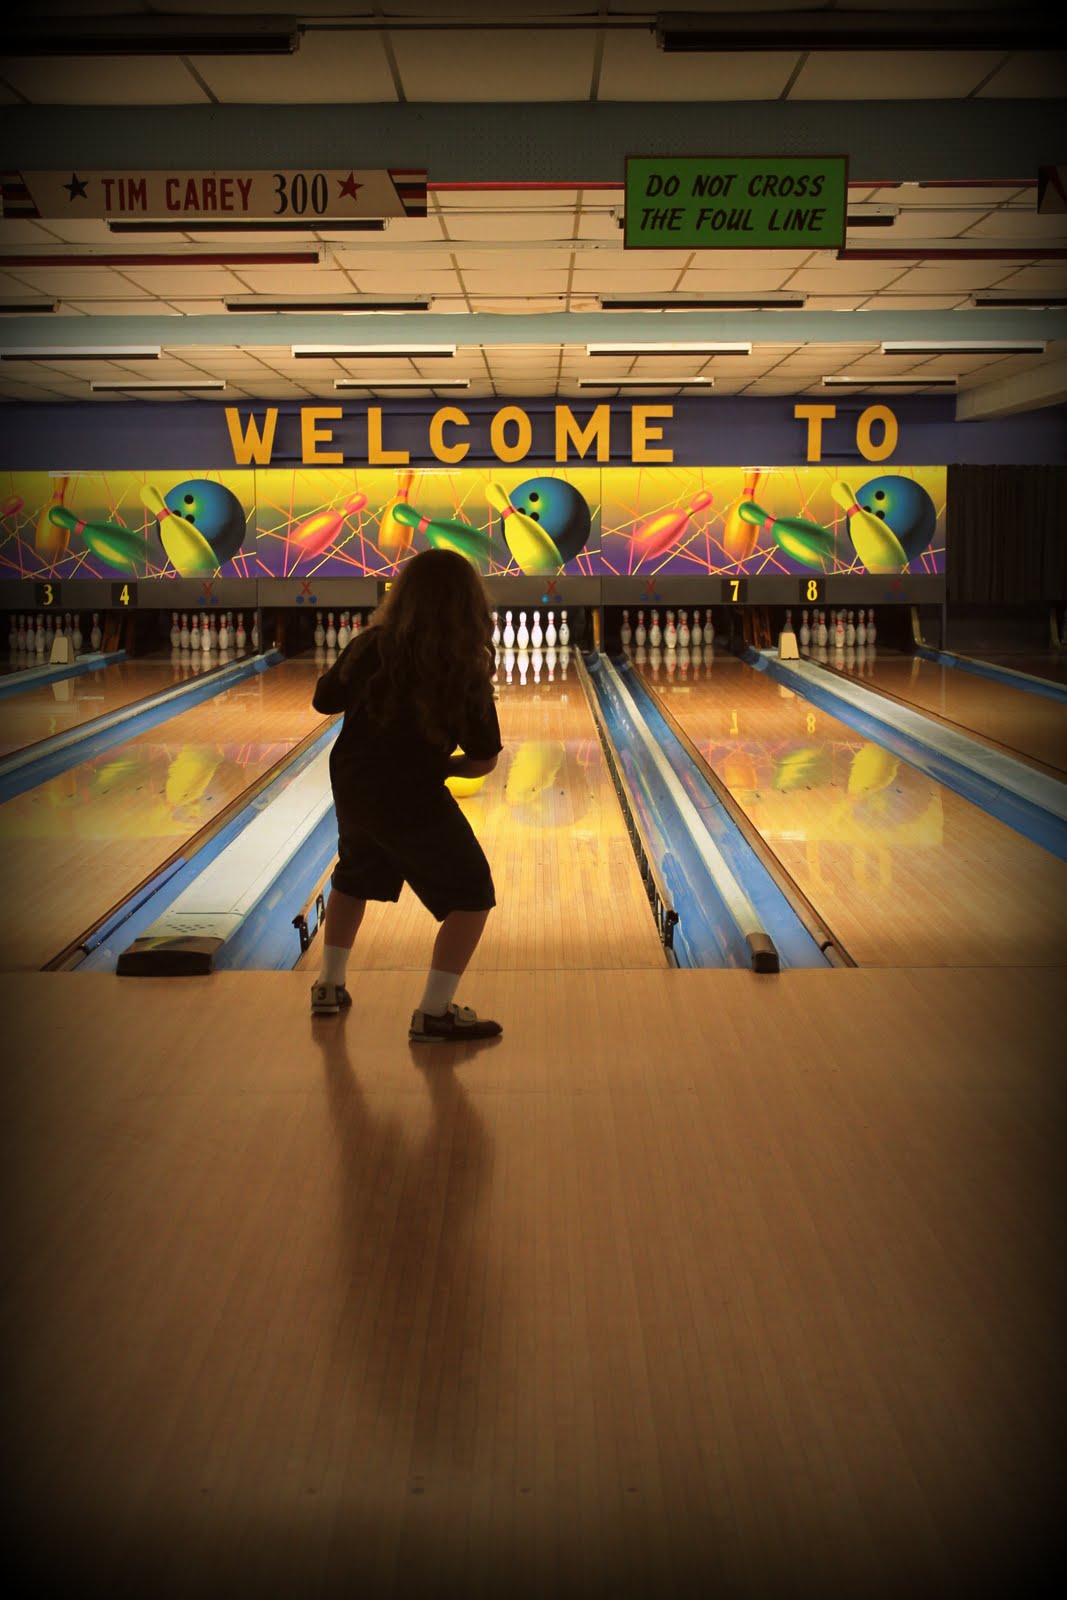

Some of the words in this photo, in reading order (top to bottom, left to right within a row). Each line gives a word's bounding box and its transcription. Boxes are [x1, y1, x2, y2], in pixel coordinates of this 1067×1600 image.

[101, 178, 147, 211] TIM
[165, 178, 253, 211] CAREY
[272, 173, 328, 214] 300
[645, 174, 681, 197] DO
[691, 174, 738, 197] NOT
[747, 174, 825, 197] CROSS
[640, 208, 686, 230] THE
[695, 208, 754, 230] FOUL
[767, 208, 826, 230] LINE
[224, 404, 674, 465] WELCOME
[794, 404, 899, 462] TO
[43, 584, 54, 606] 3
[119, 584, 130, 606] 4
[729, 580, 740, 602] 7
[806, 579, 818, 602] 8
